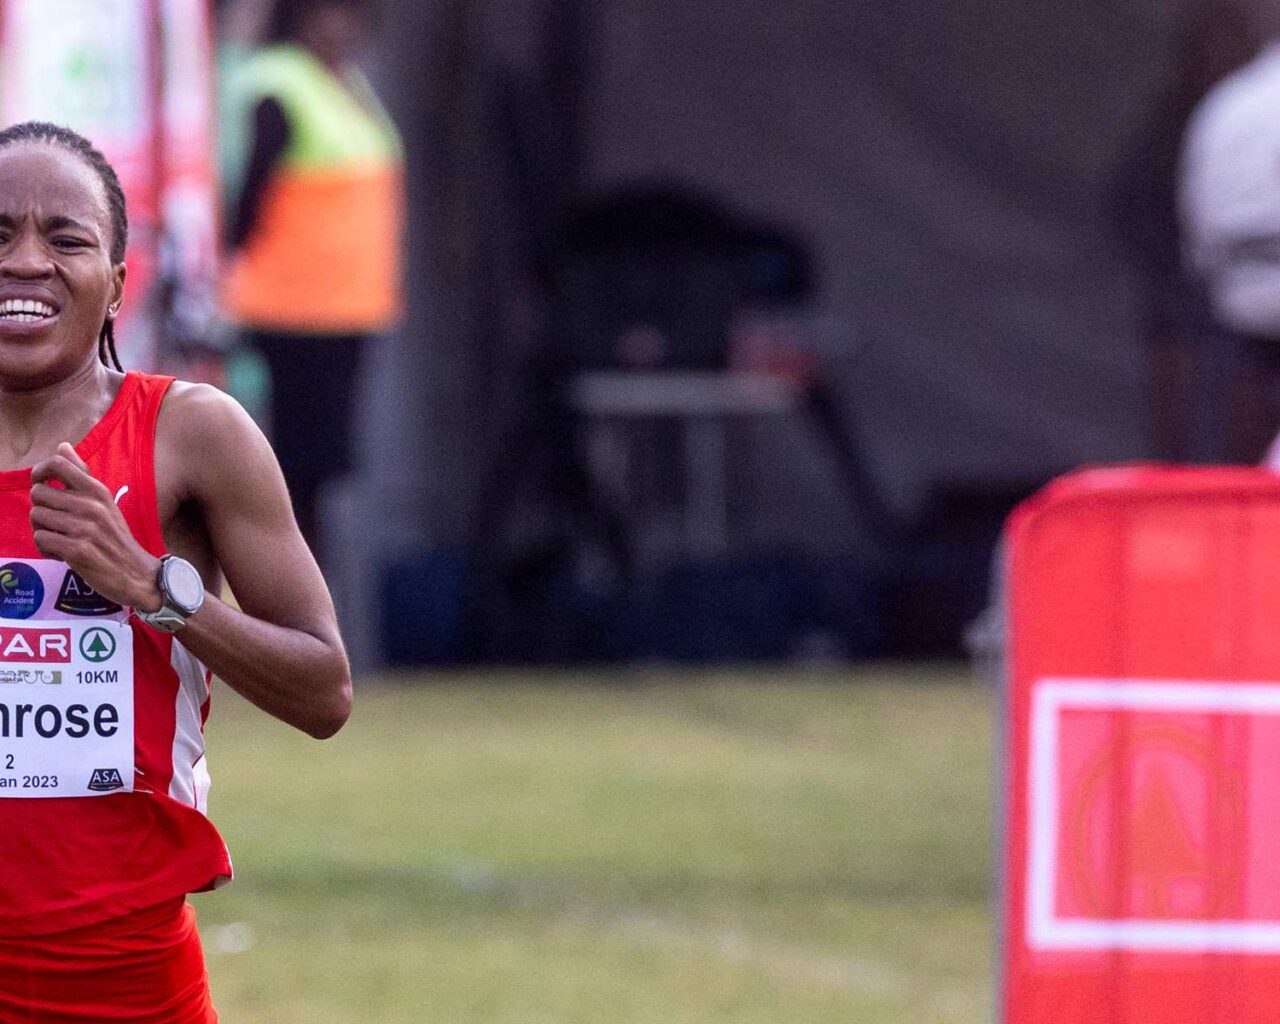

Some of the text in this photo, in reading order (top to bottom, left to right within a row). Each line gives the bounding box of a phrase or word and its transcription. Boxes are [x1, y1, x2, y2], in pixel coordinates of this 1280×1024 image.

[15, 588, 35, 597] Road
[4, 596, 34, 605] Accident
[76, 670, 119, 684] 10KM
[5, 754, 15, 770] 2
[22, 775, 59, 788] 2023
[92, 770, 120, 783] ASA
